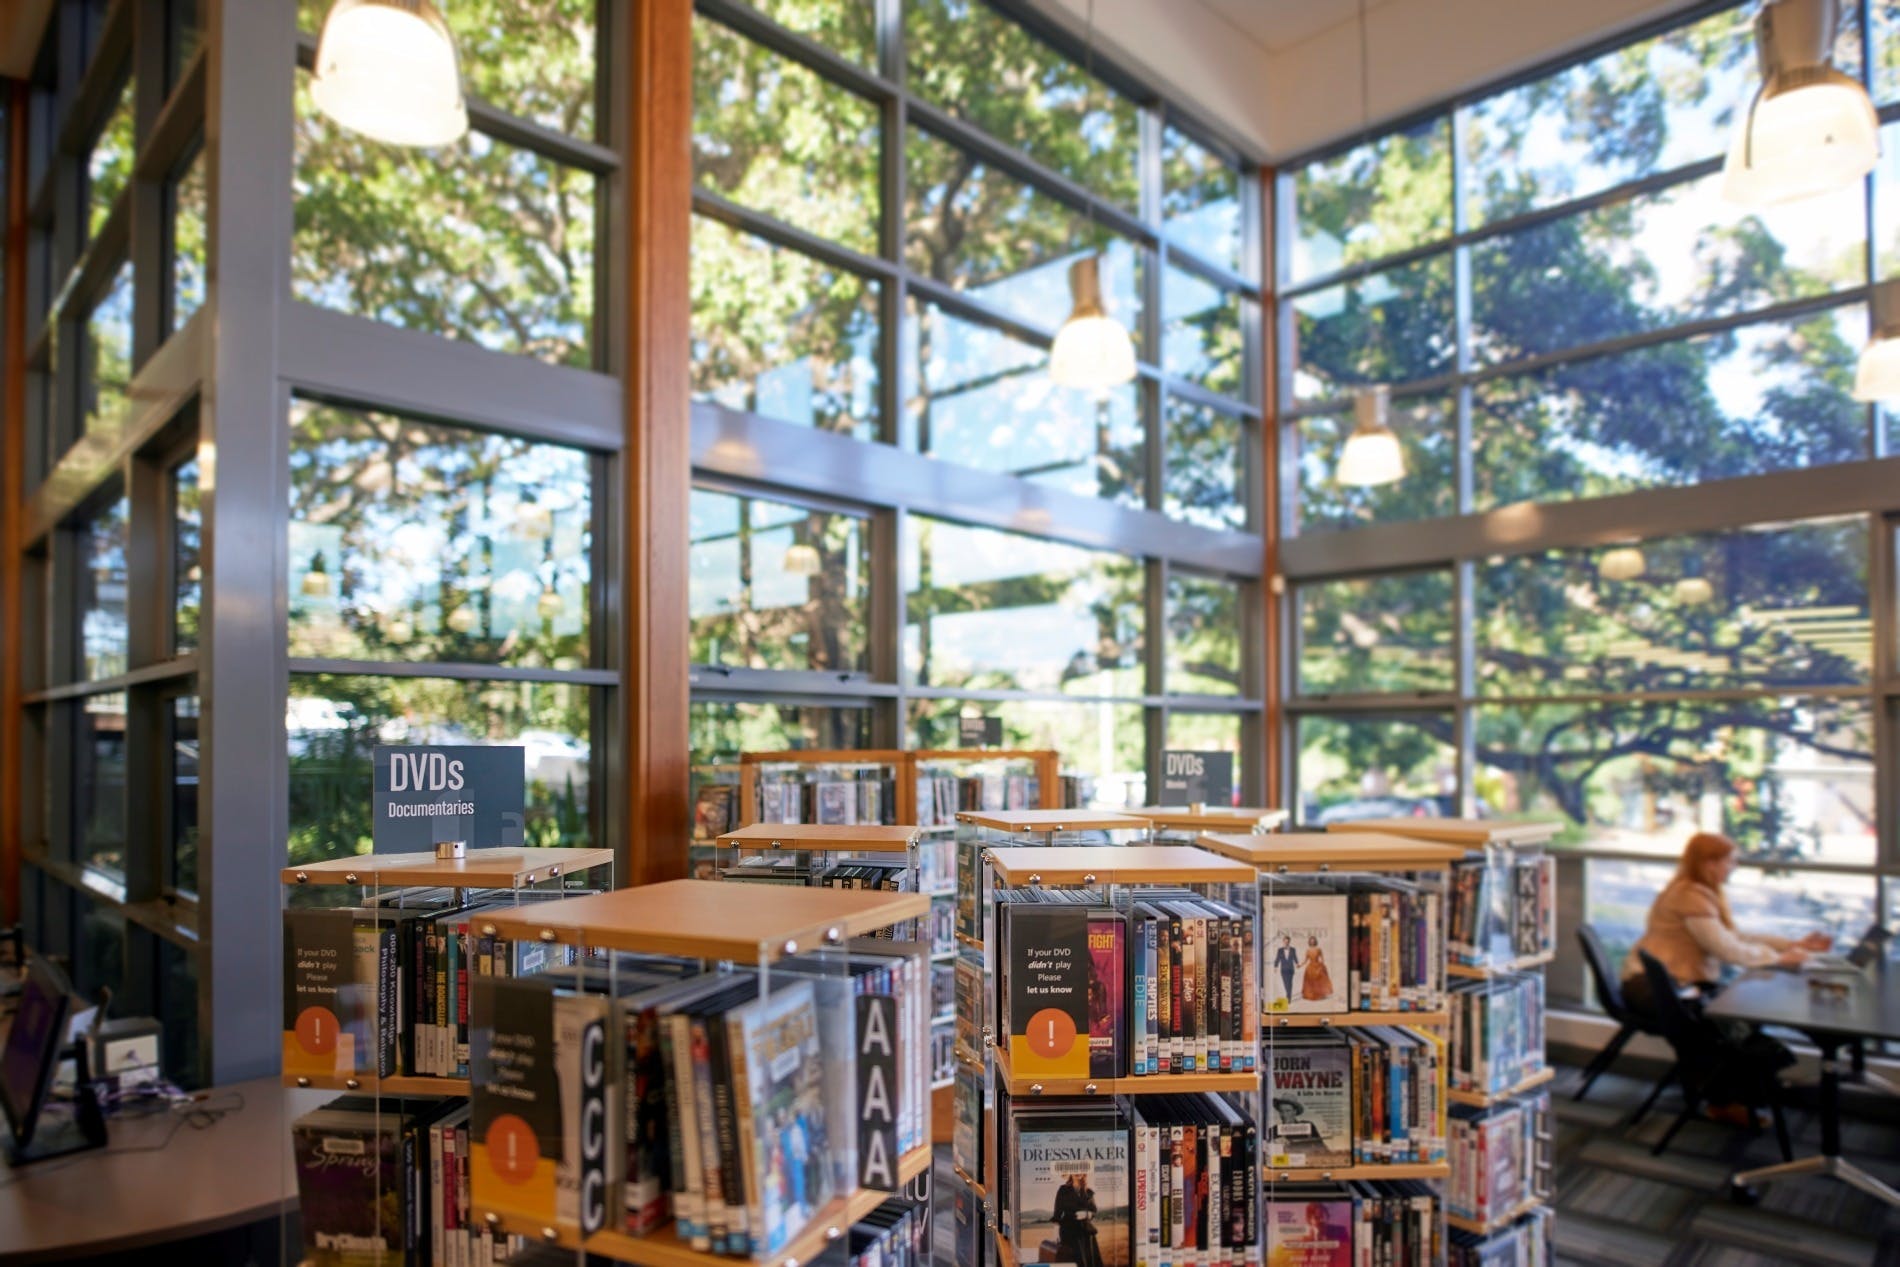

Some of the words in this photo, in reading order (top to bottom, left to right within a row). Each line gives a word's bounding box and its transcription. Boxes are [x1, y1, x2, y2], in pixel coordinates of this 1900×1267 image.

[390, 753, 464, 792] DVDs
[1166, 754, 1204, 776] DVDs
[388, 800, 474, 818] Documentaries
[1519, 868, 1535, 894] K
[1520, 896, 1535, 923] K
[1088, 934, 1114, 949] FIGHT
[1520, 926, 1535, 953] K
[380, 948, 388, 1014] Philosophy
[1028, 961, 1053, 969] didn't
[318, 986, 337, 994] know
[1135, 975, 1145, 1007] EDIE
[1147, 977, 1157, 1020] EMPTIES
[388, 981, 397, 1045] Knowledge
[862, 1000, 891, 1056] A
[584, 1024, 604, 1088] C
[1273, 1058, 1311, 1070] JOHN
[863, 1065, 892, 1123] A
[1273, 1072, 1343, 1089] WAYNE
[583, 1098, 604, 1161] C
[864, 1130, 892, 1187] A
[1023, 1147, 1125, 1161] DRESSMAKER
[582, 1168, 603, 1232] C
[1138, 1169, 1146, 1211] EXPRESSO
[1211, 1173, 1220, 1239] EX_MACHINA
